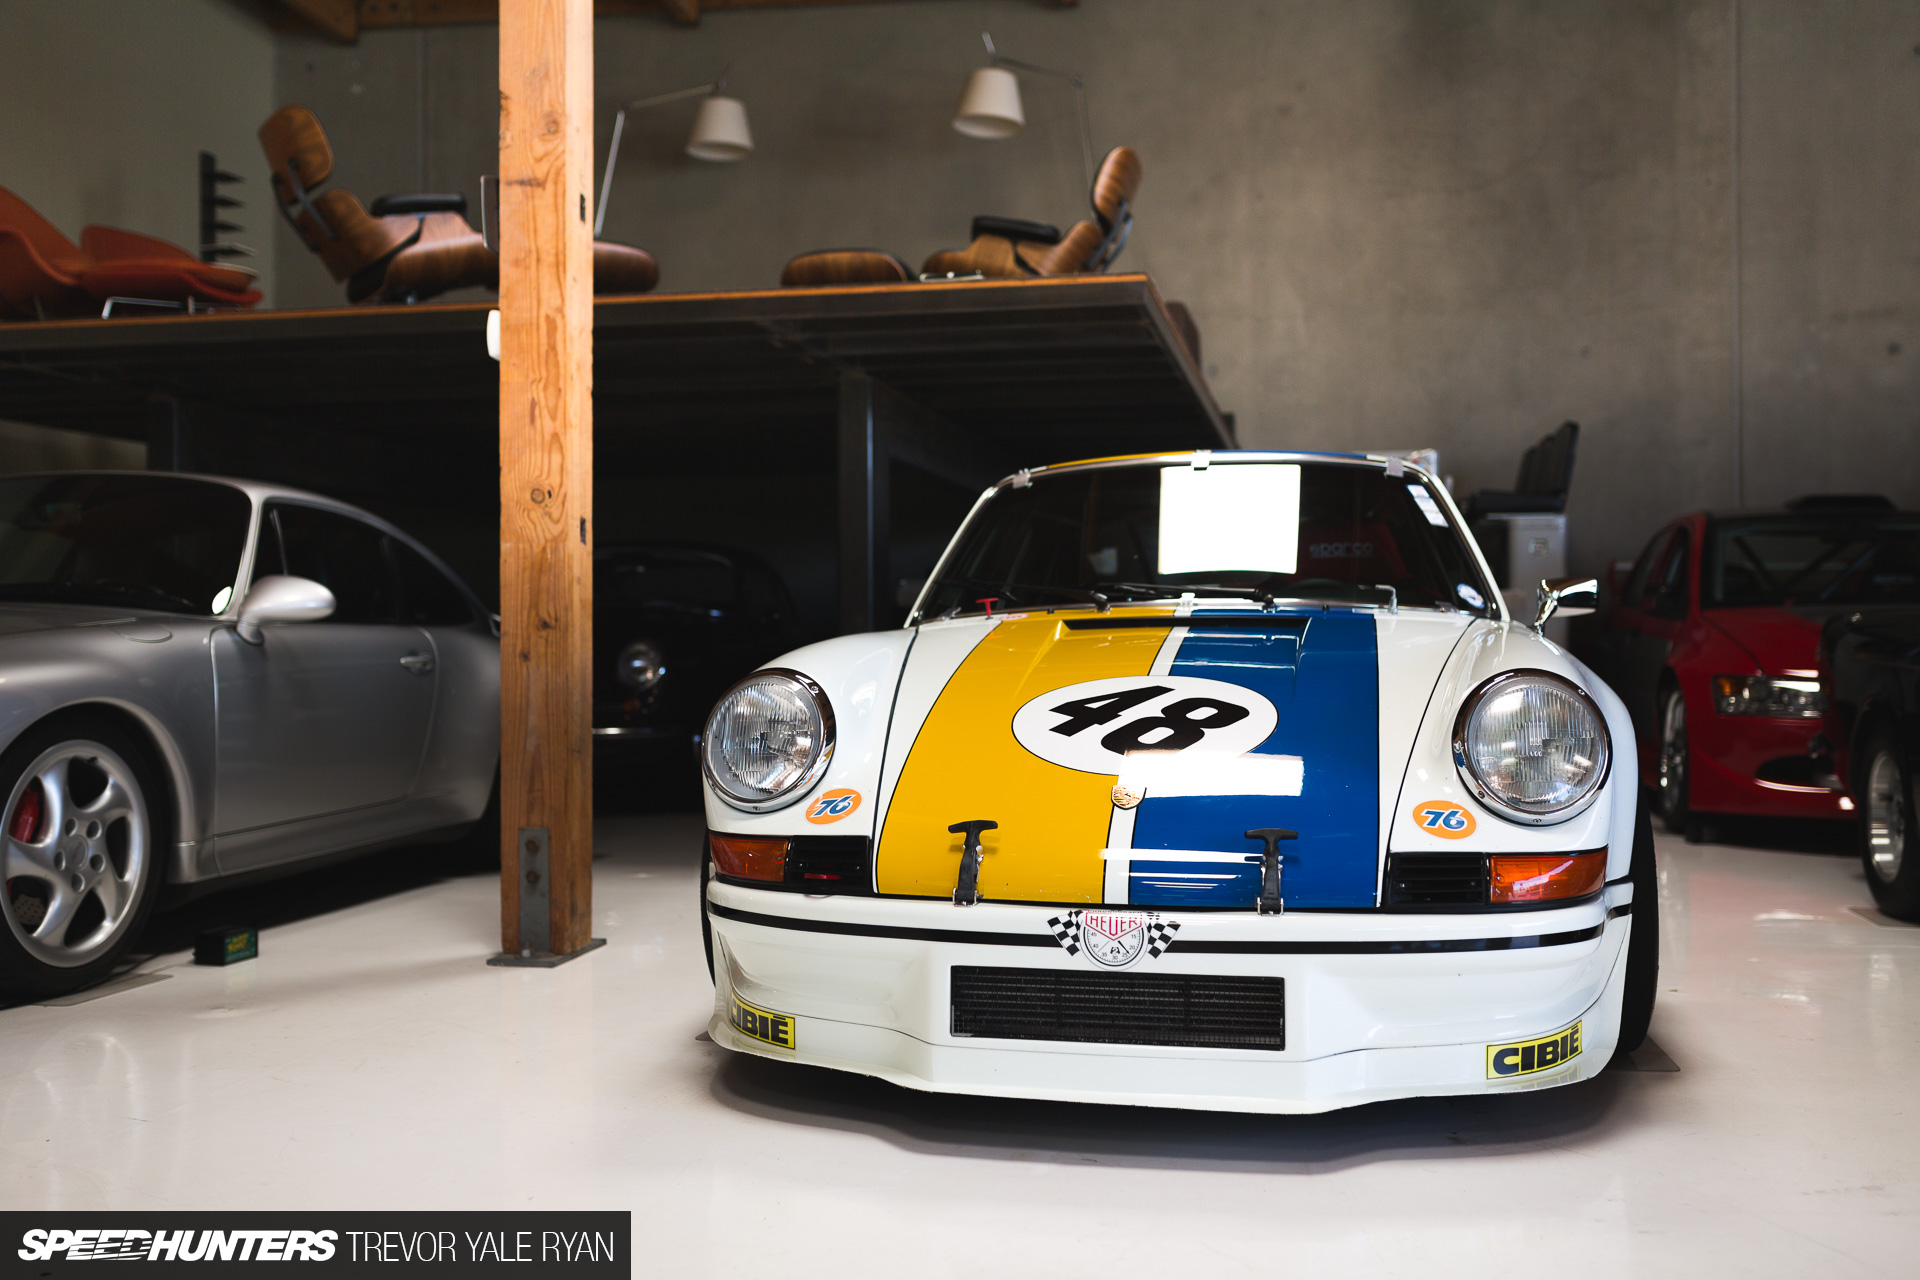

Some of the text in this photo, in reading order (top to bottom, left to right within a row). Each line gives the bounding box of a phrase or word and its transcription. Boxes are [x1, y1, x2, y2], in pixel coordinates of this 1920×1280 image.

[1047, 685, 1251, 756] 48
[811, 795, 855, 816] 76
[1421, 809, 1466, 830] 76
[1090, 915, 1138, 936] HEUER
[1493, 1025, 1579, 1075] CIBIÉ
